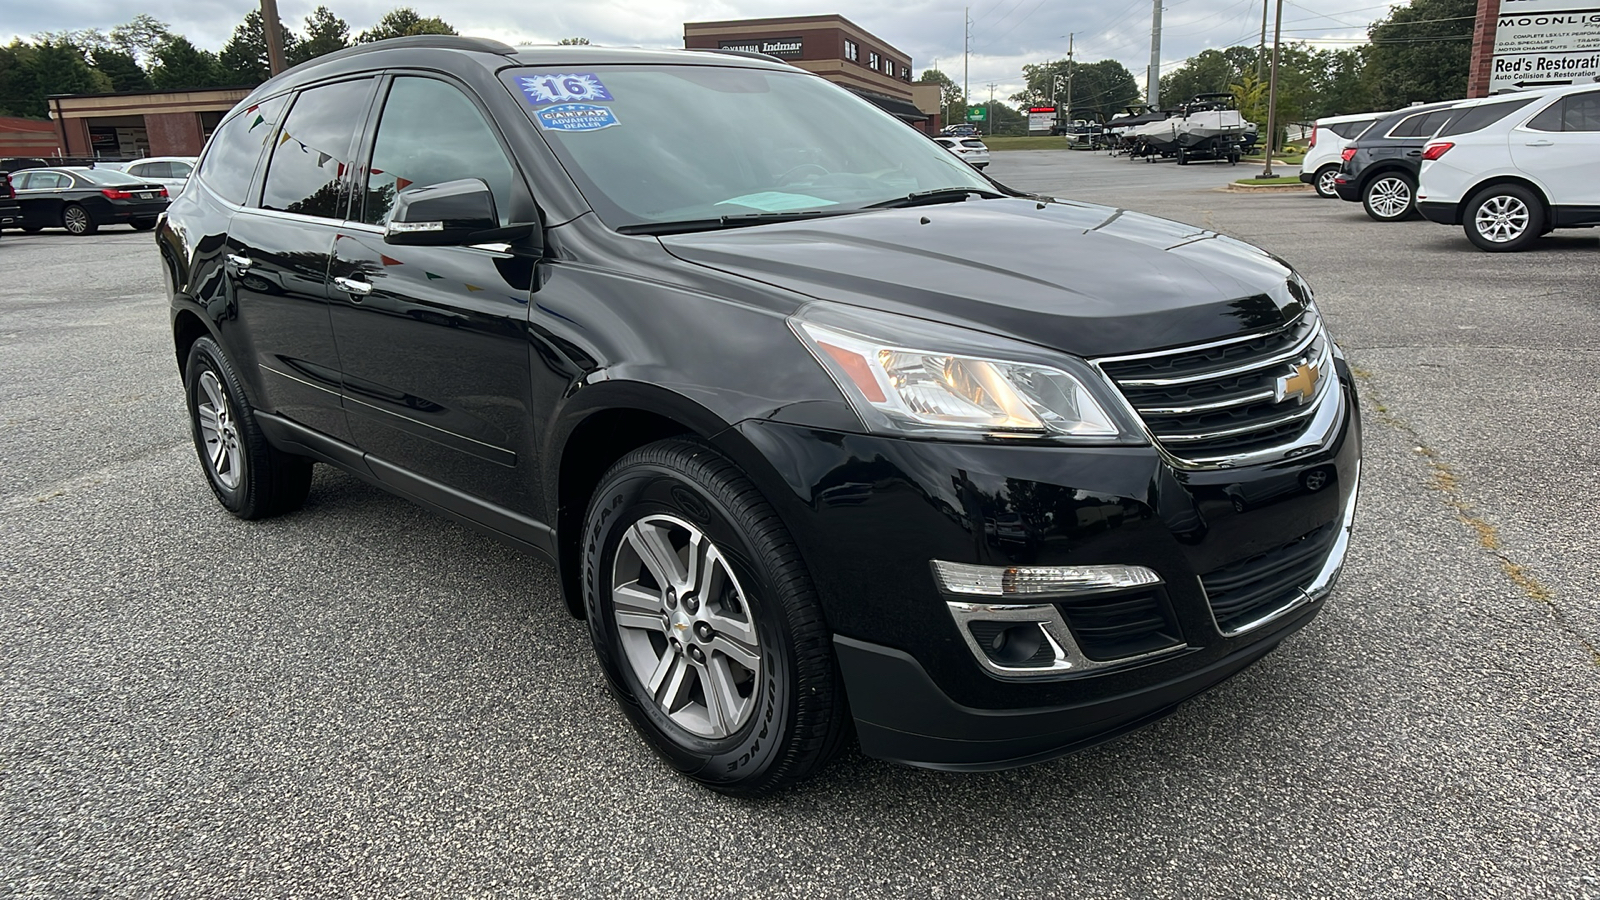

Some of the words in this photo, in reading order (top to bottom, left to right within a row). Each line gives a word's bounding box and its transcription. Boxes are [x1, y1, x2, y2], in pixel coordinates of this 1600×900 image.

[1498, 15, 1600, 27] MOONLIG
[762, 42, 802, 52] Indmar
[1495, 57, 1532, 72] Red's
[1536, 54, 1600, 71] Restorati
[1553, 70, 1597, 78] Restoration
[541, 77, 586, 96] 16
[542, 109, 609, 120] CARFAX
[551, 116, 608, 125] ADVANTAGE
